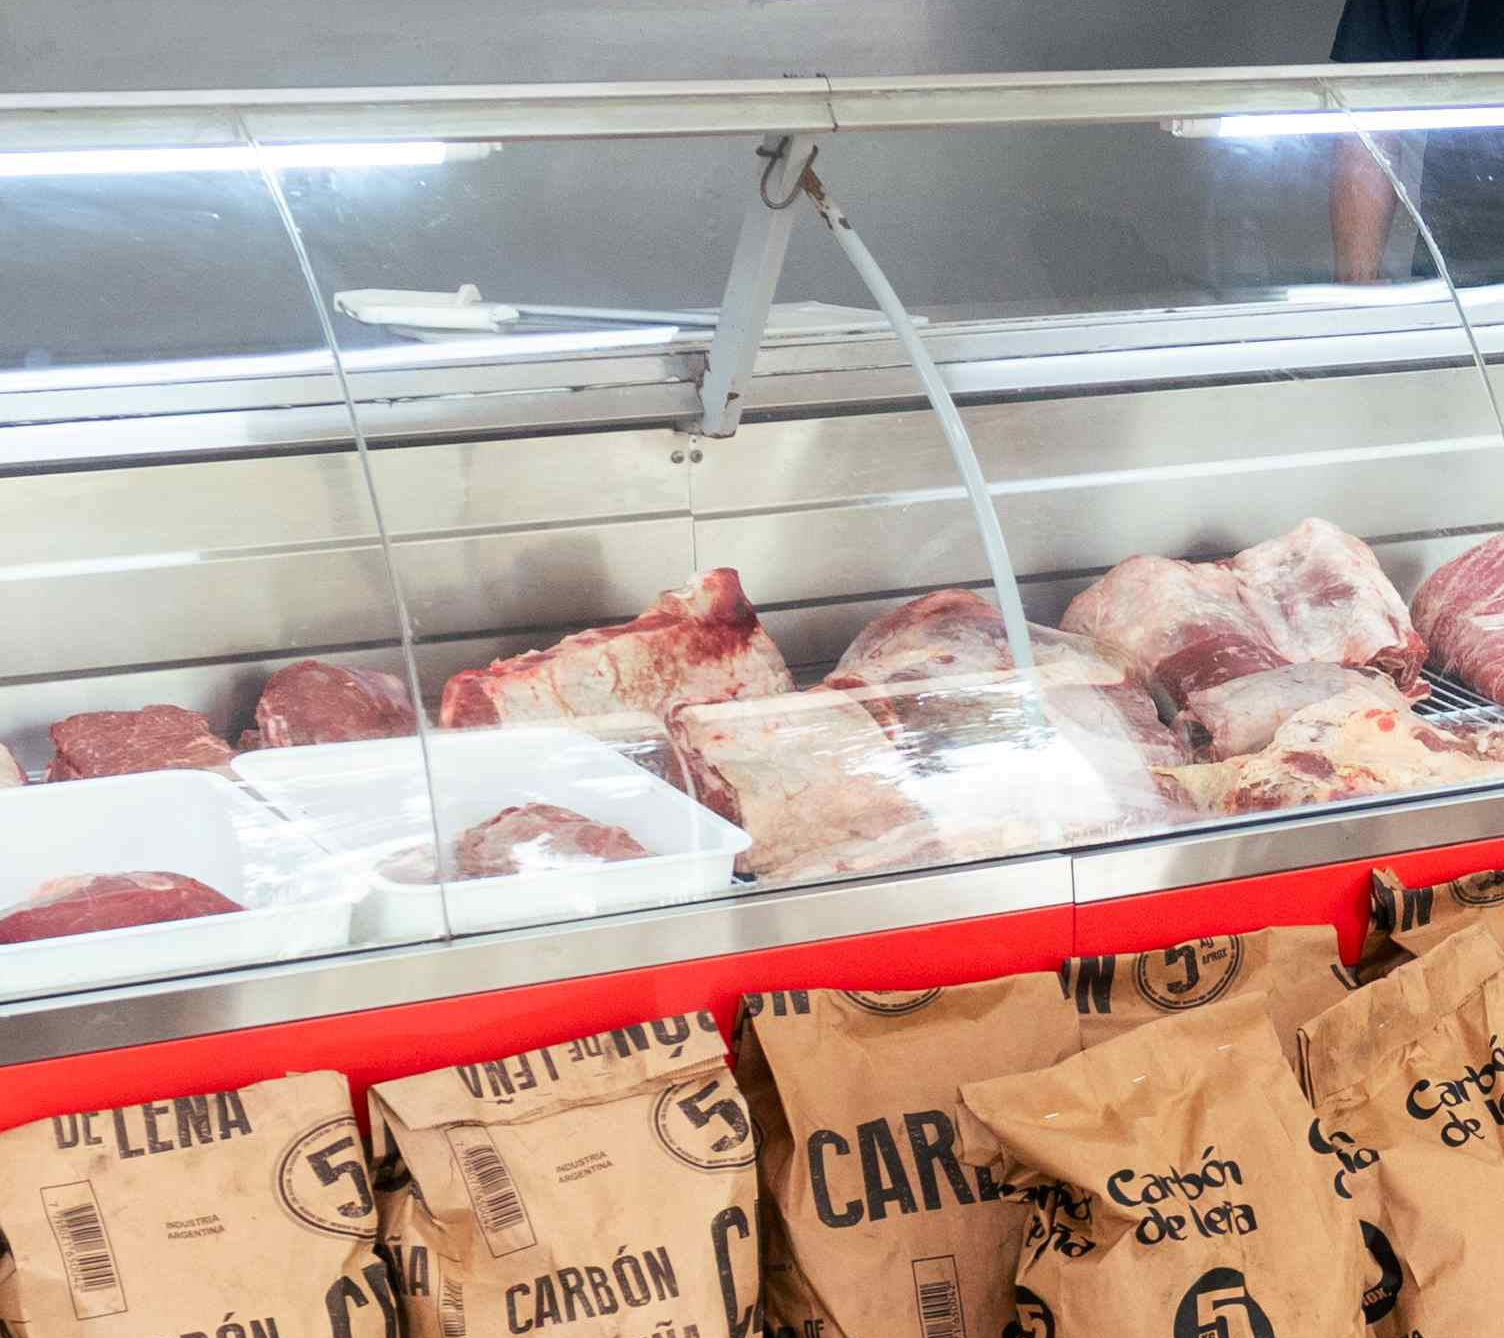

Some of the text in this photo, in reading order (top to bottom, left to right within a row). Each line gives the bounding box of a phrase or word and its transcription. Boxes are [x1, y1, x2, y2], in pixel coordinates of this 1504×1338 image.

[677, 1080, 751, 1153] 5
[1440, 1111, 1487, 1148] de
[306, 1135, 375, 1219] 5
[556, 1150, 608, 1174] INDUSTRIA
[557, 1160, 615, 1184] ARGENTINA
[1107, 1146, 1242, 1207] Carbón
[167, 1223, 227, 1240] ARGENTINA
[1136, 1206, 1188, 1246] de
[505, 1245, 680, 1336] CARBÓN
